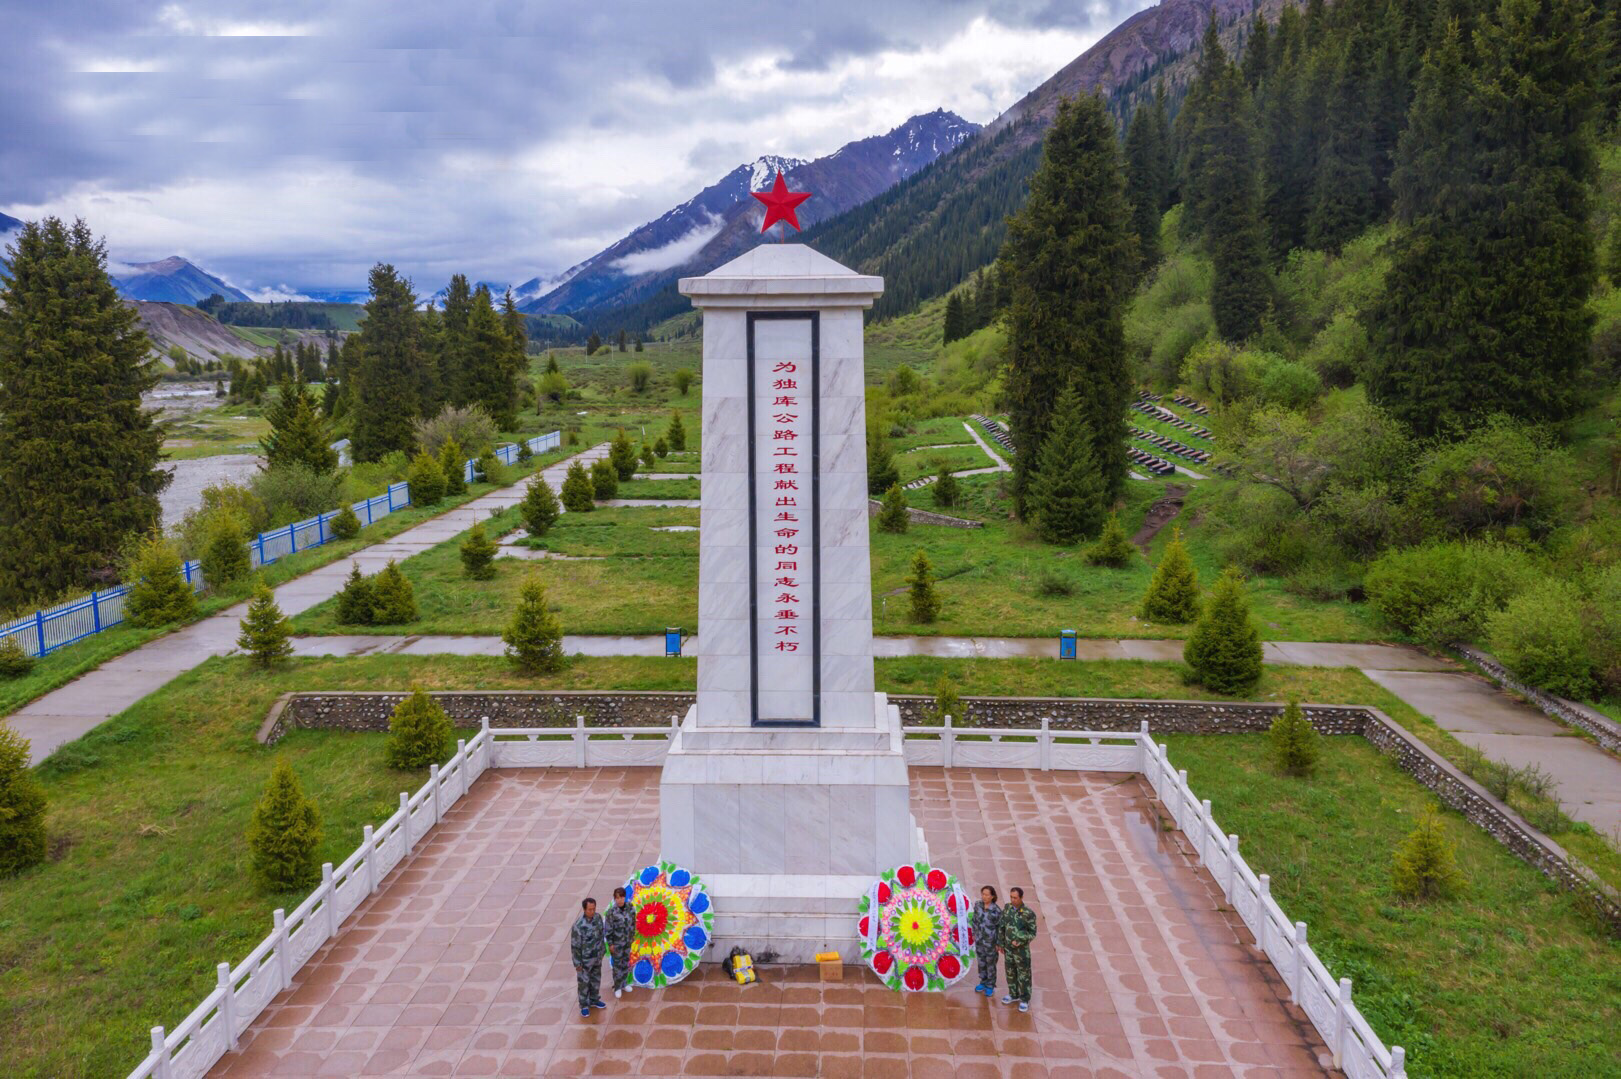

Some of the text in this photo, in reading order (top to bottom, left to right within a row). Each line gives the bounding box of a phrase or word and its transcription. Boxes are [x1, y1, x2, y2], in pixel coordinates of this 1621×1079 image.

[772, 361, 800, 652] 为独库公路工程献出生命的同志永垂不朽
